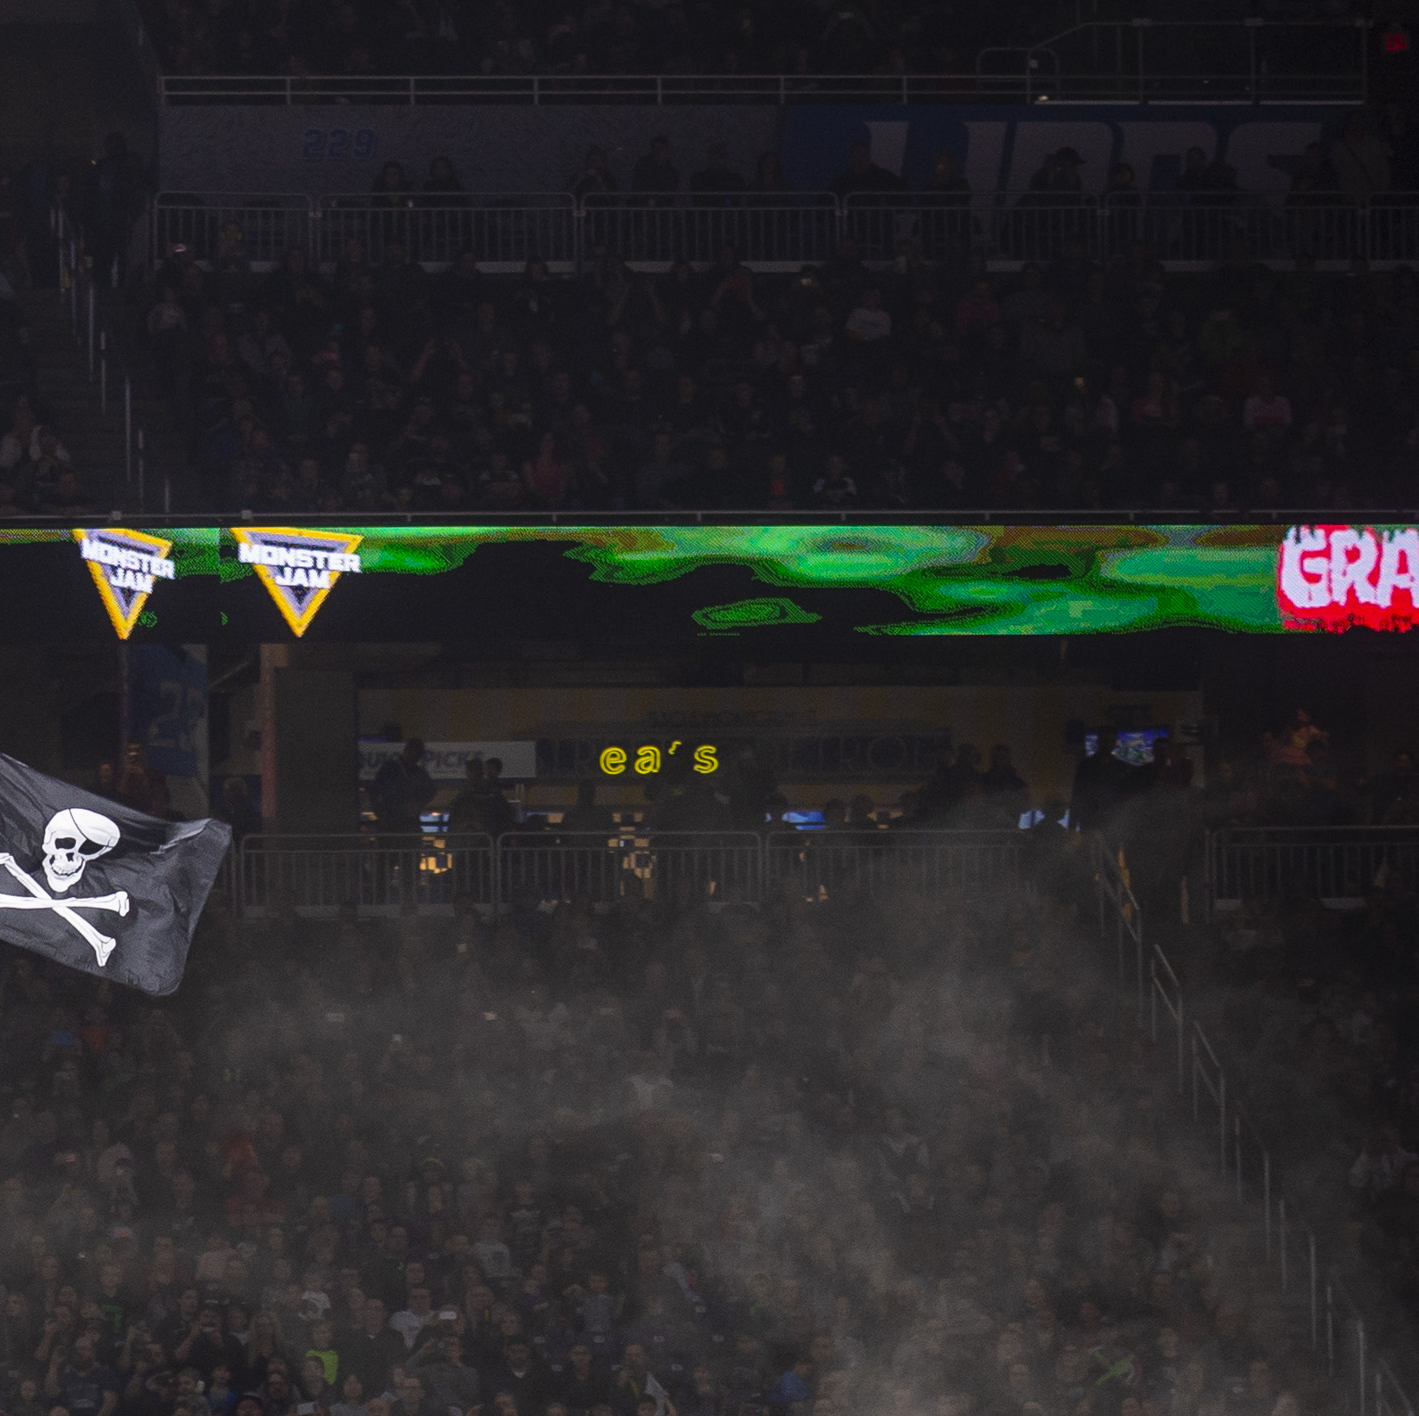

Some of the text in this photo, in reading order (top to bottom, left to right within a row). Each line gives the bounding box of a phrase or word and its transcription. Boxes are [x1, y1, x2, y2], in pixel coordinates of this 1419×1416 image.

[303, 129, 374, 158] 229
[81, 537, 177, 580] MONSTER
[236, 541, 363, 574] MONSTER
[110, 568, 155, 594] JAM
[276, 565, 332, 590] JAM
